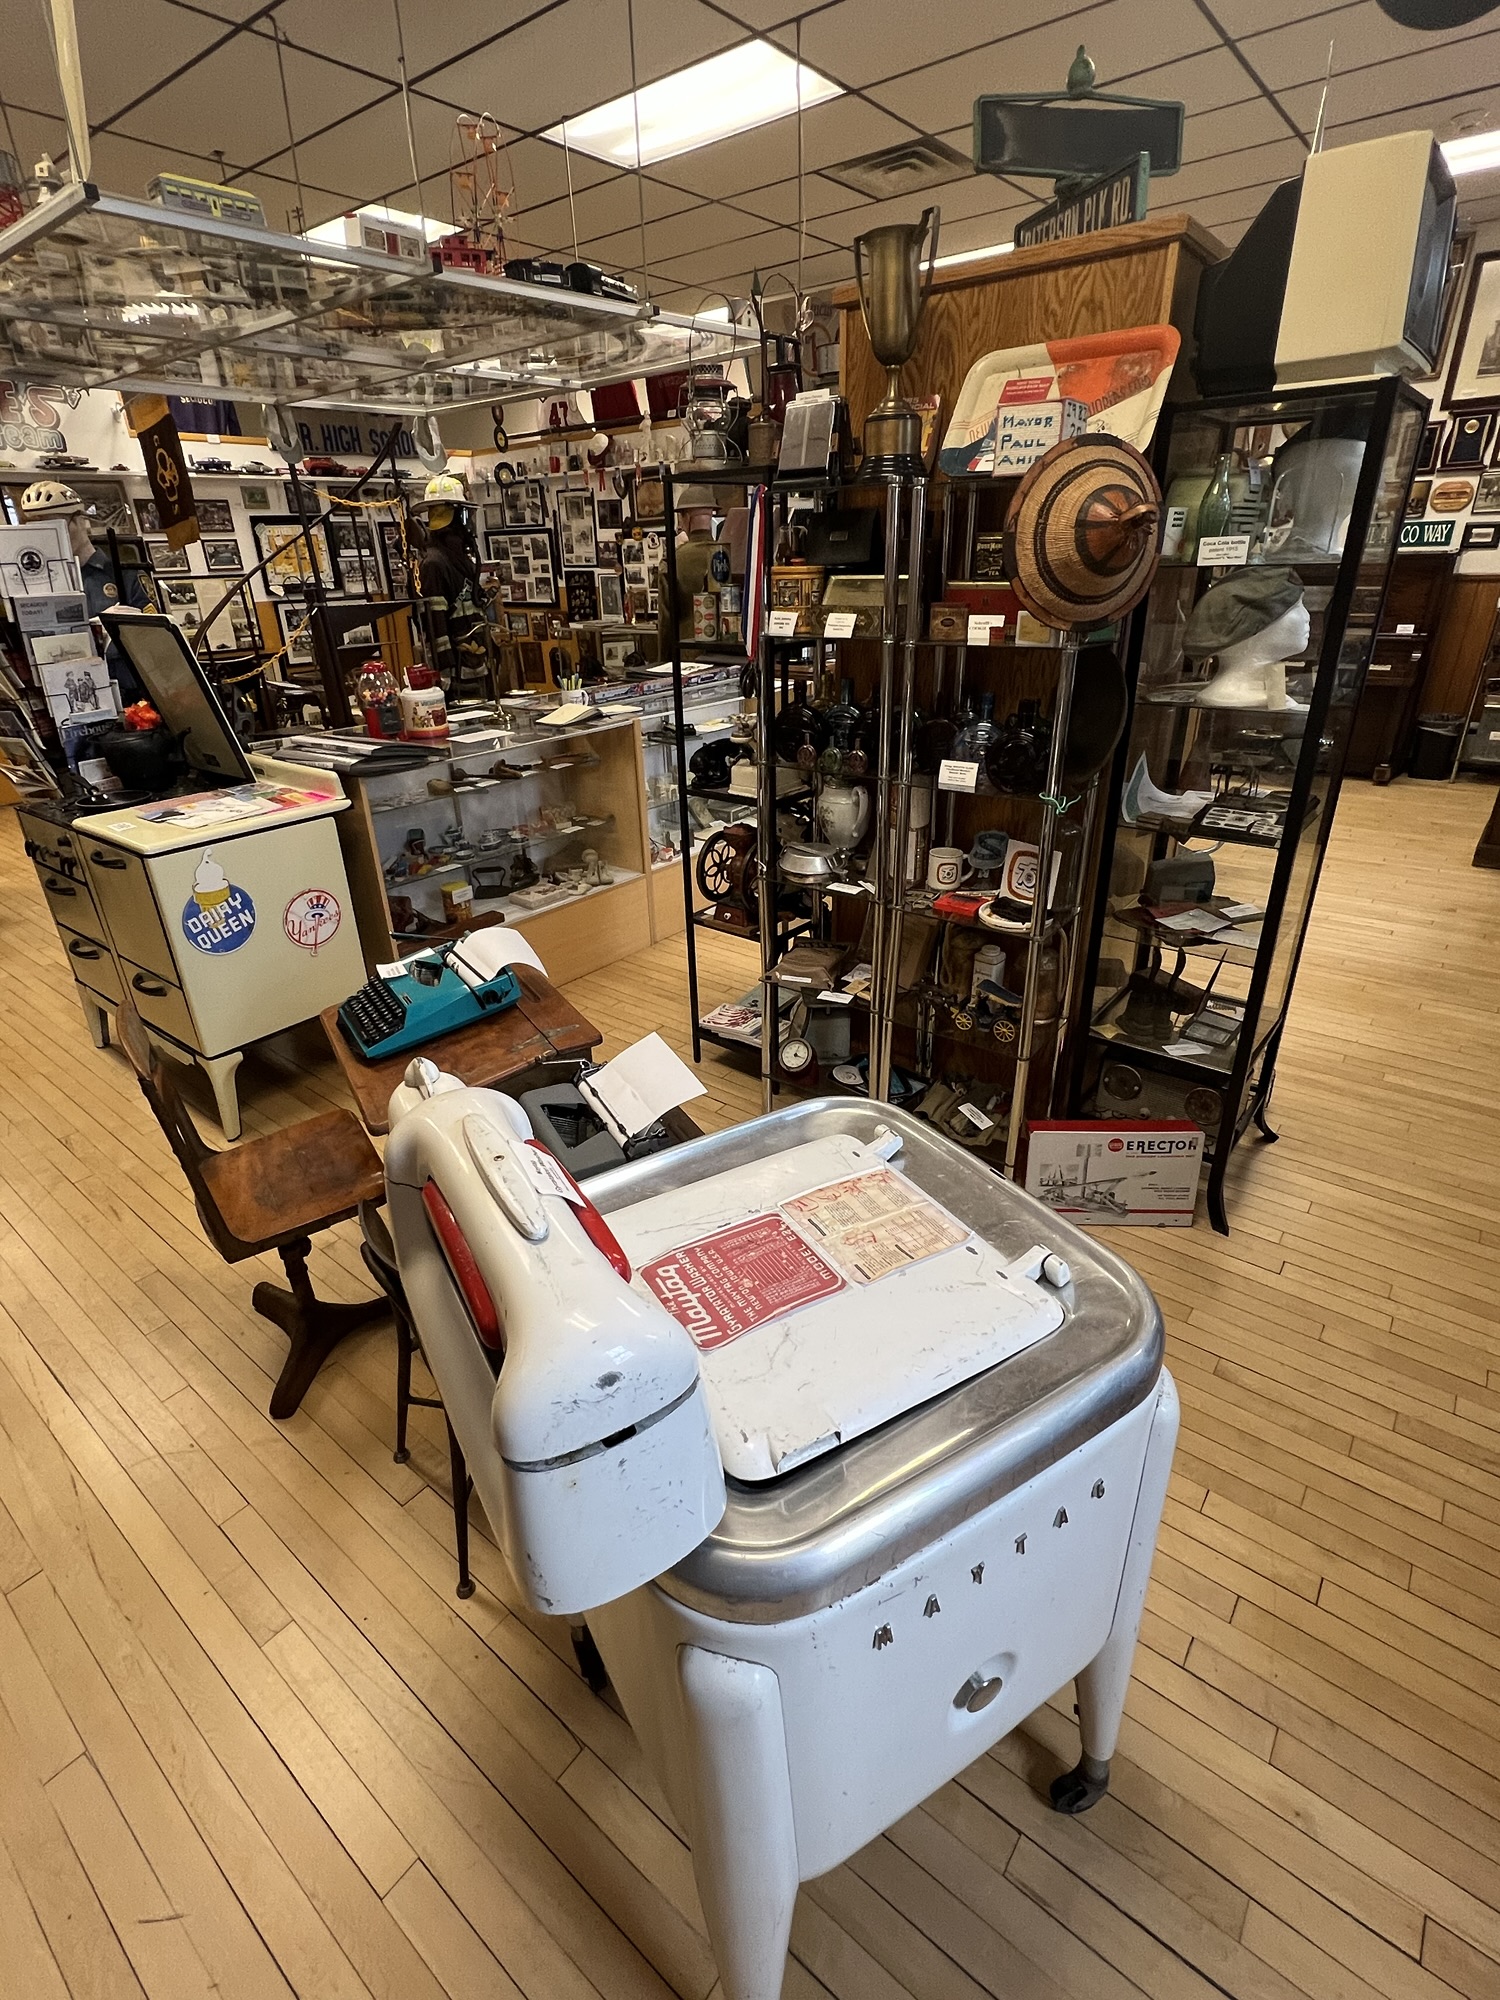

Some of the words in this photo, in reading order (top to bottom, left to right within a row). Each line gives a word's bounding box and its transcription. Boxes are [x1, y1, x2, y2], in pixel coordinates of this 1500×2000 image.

[1083, 186, 1108, 235] PLK
[1111, 176, 1132, 227] RD.
[549, 402, 568, 427] 47
[1002, 415, 1053, 428] MAYOR
[321, 424, 362, 453] HIGH
[1001, 433, 1046, 450] PAUL
[1424, 523, 1452, 543] WAY
[187, 893, 242, 934] DAIRY
[197, 910, 255, 949] QUEEN
[794, 1243, 833, 1279] MODEL
[646, 1261, 730, 1345] Maytag
[872, 1477, 1106, 1651] MAYTAG
